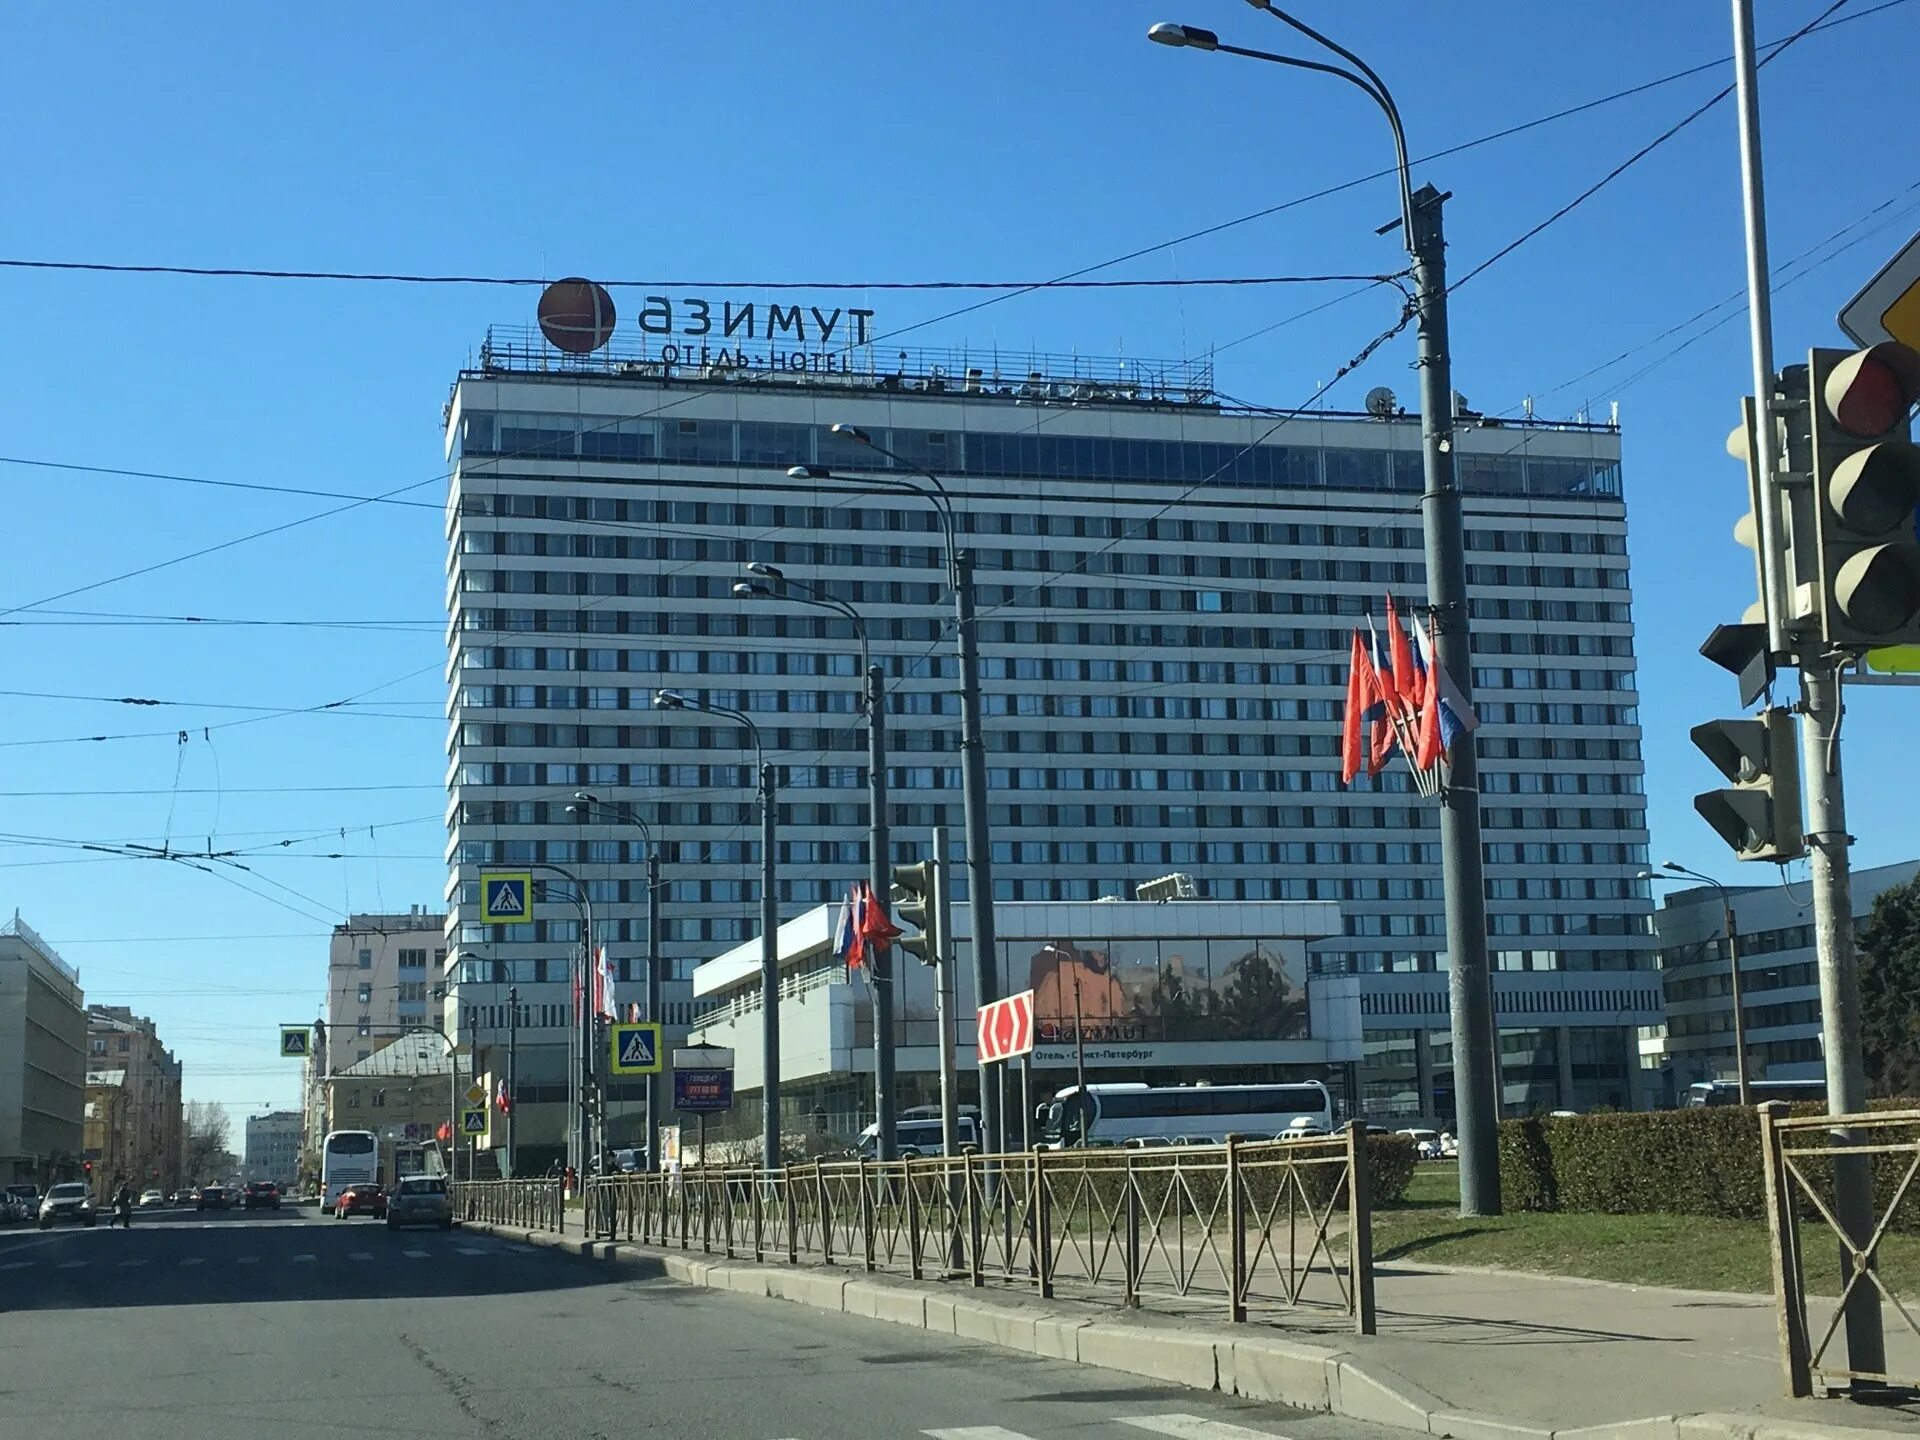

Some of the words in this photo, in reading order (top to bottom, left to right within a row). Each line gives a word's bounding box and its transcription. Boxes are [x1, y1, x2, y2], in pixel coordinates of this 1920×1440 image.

[662, 344, 749, 369] ОТЕЛЬ
[771, 351, 852, 373] HOTEL
[1035, 1051, 1065, 1060] Отель
[1071, 1049, 1154, 1060] Снкт-Петербург
